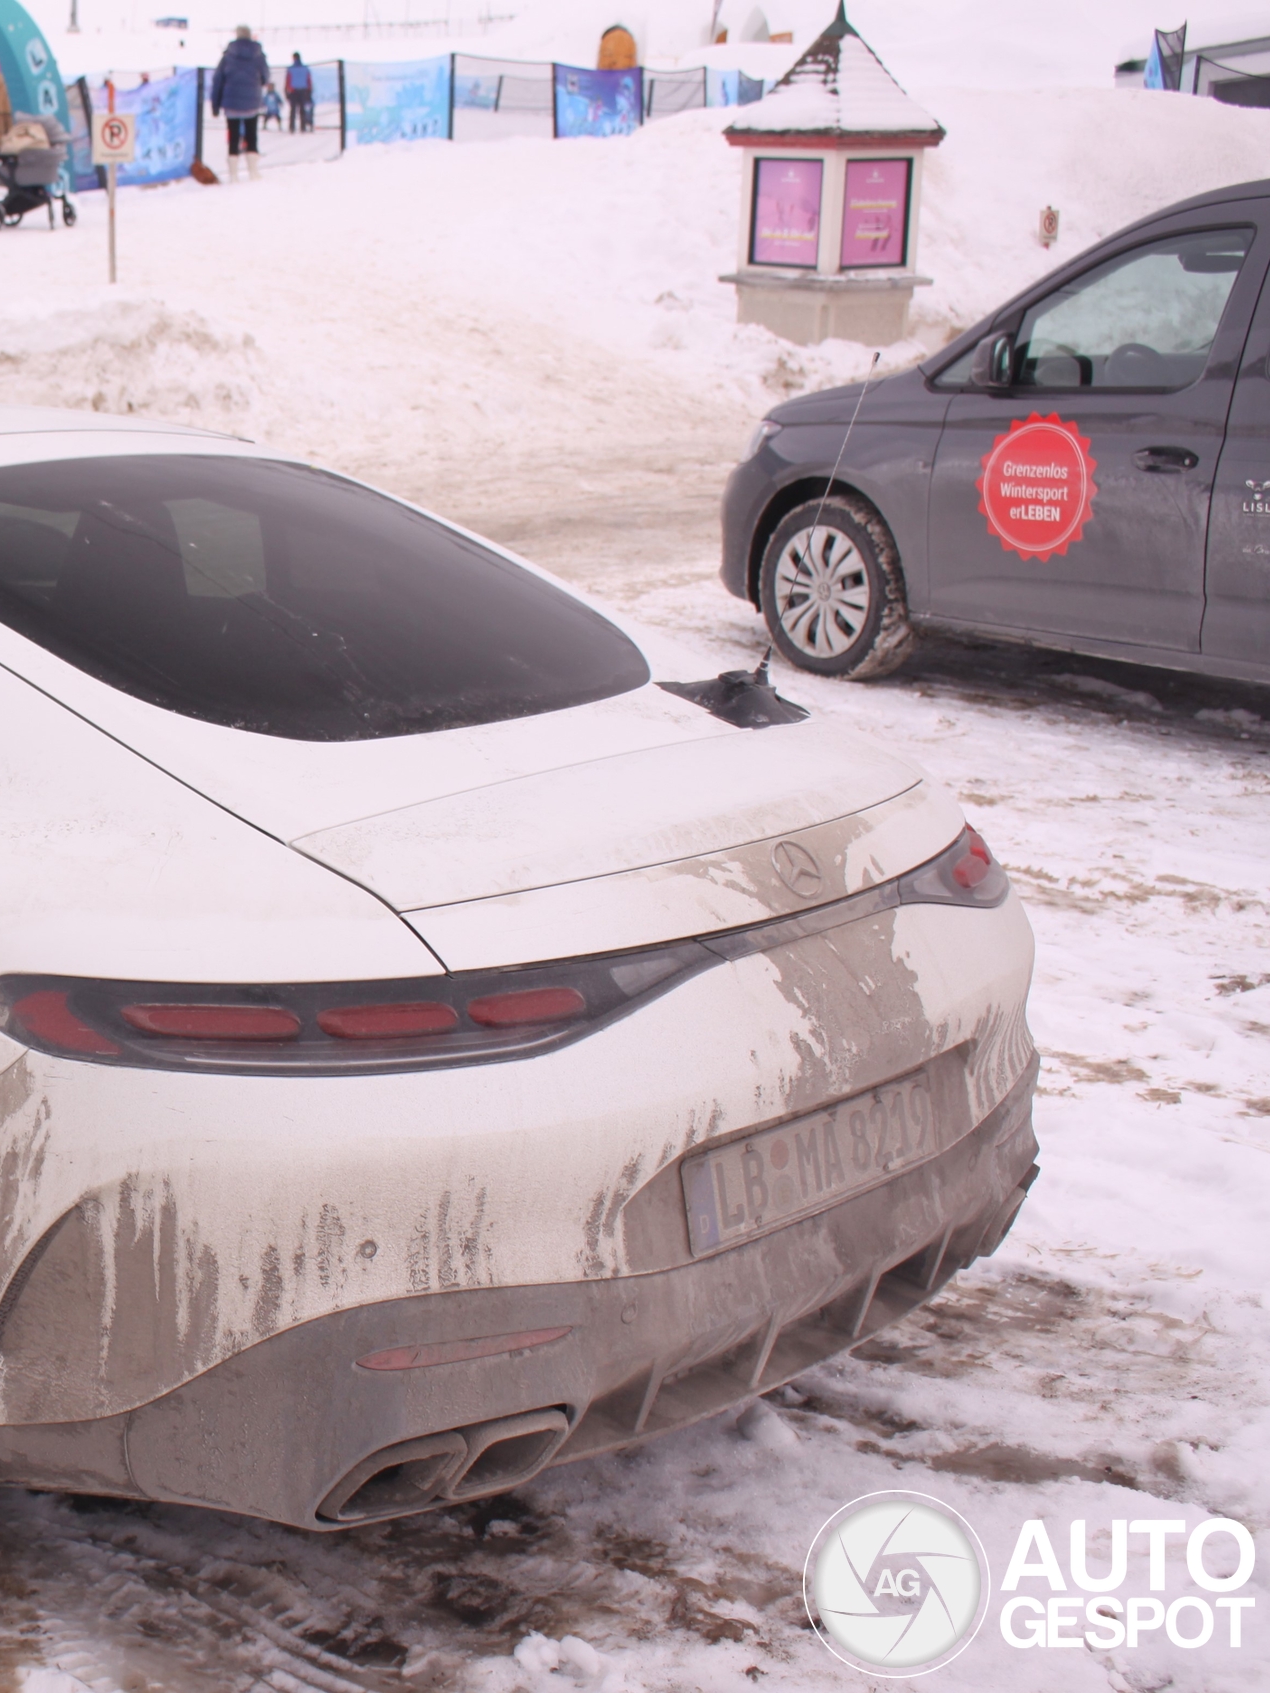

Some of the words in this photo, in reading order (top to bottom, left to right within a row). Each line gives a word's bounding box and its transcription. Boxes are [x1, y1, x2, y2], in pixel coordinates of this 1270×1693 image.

[1003, 461, 1068, 479] Grenzenlos
[1000, 482, 1068, 503] Wintersport
[1010, 504, 1060, 522] erLEBEN
[715, 1149, 769, 1230] LB
[795, 1121, 846, 1199] MA
[699, 1214, 710, 1234] D
